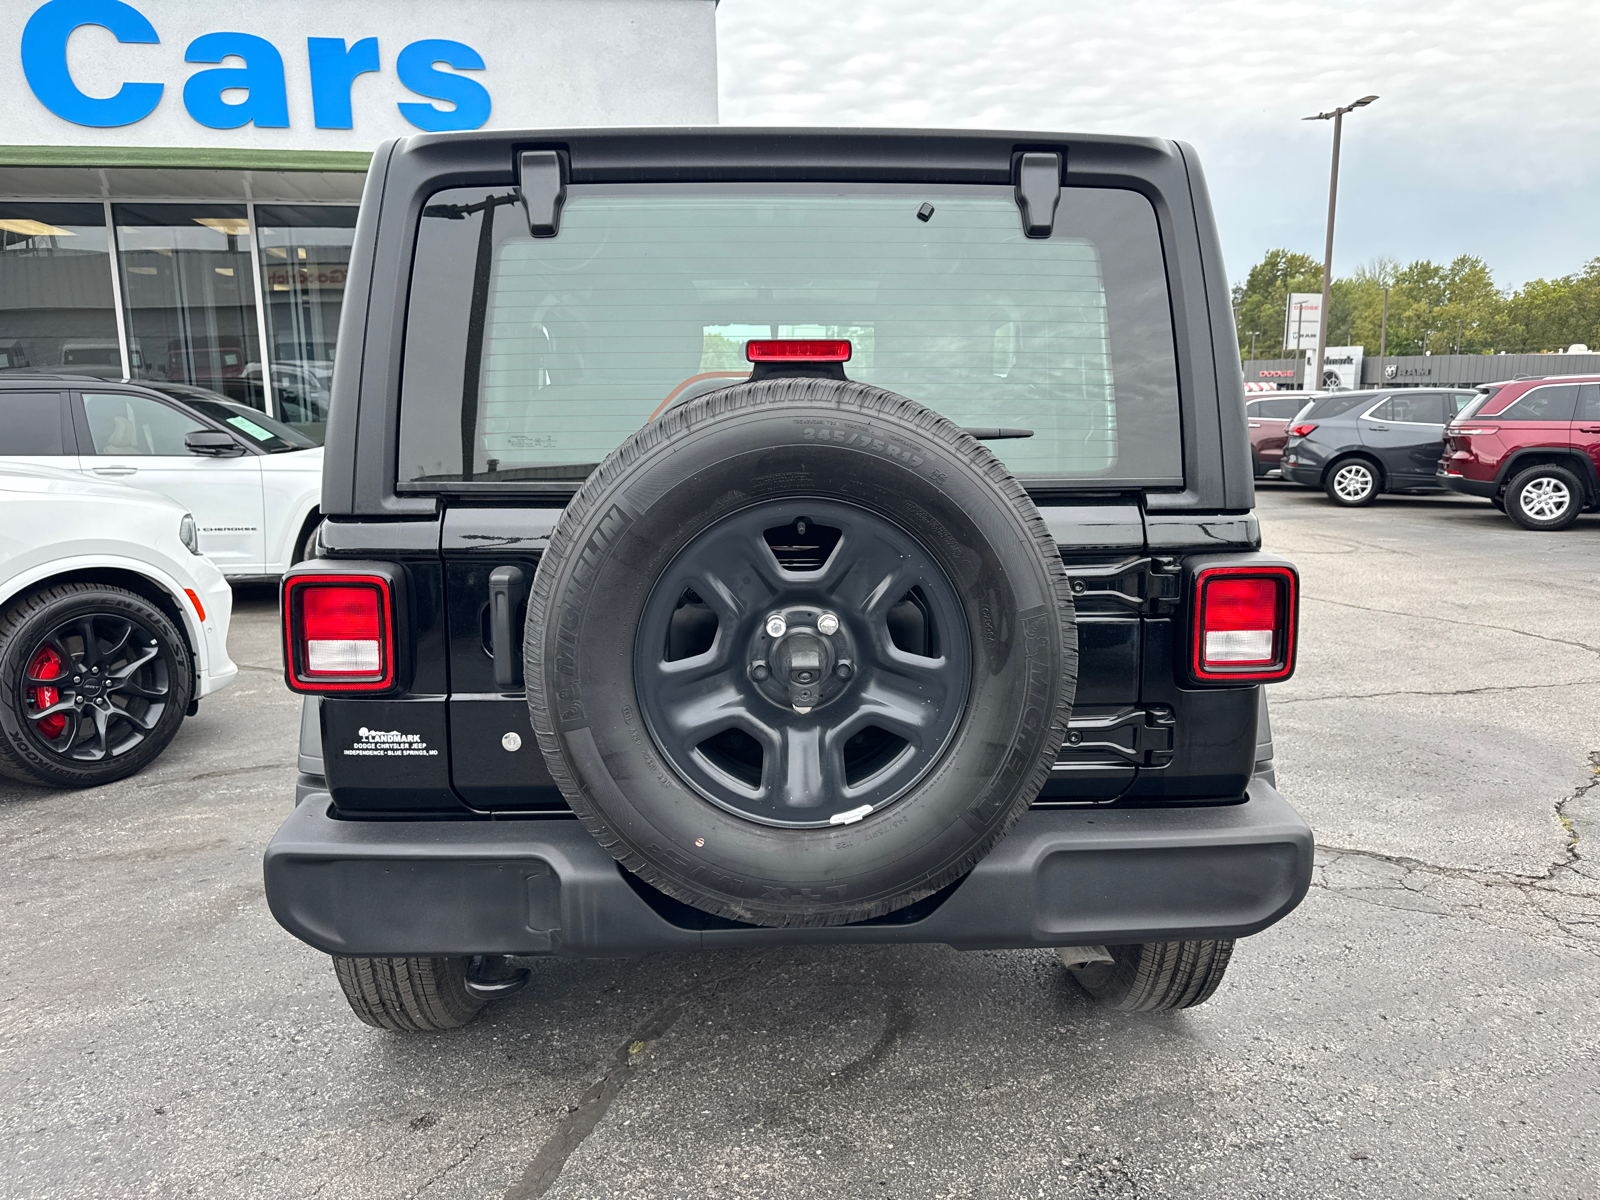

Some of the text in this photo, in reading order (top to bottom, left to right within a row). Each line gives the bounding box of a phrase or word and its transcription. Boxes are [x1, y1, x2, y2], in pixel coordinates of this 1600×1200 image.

[21, 0, 492, 132] Cars
[1307, 355, 1354, 366] Ldmark
[803, 428, 924, 468] 245/75R17
[556, 507, 624, 676] MICHELIN
[368, 734, 421, 742] LANDMARK
[977, 660, 1049, 812] MICHELIN
